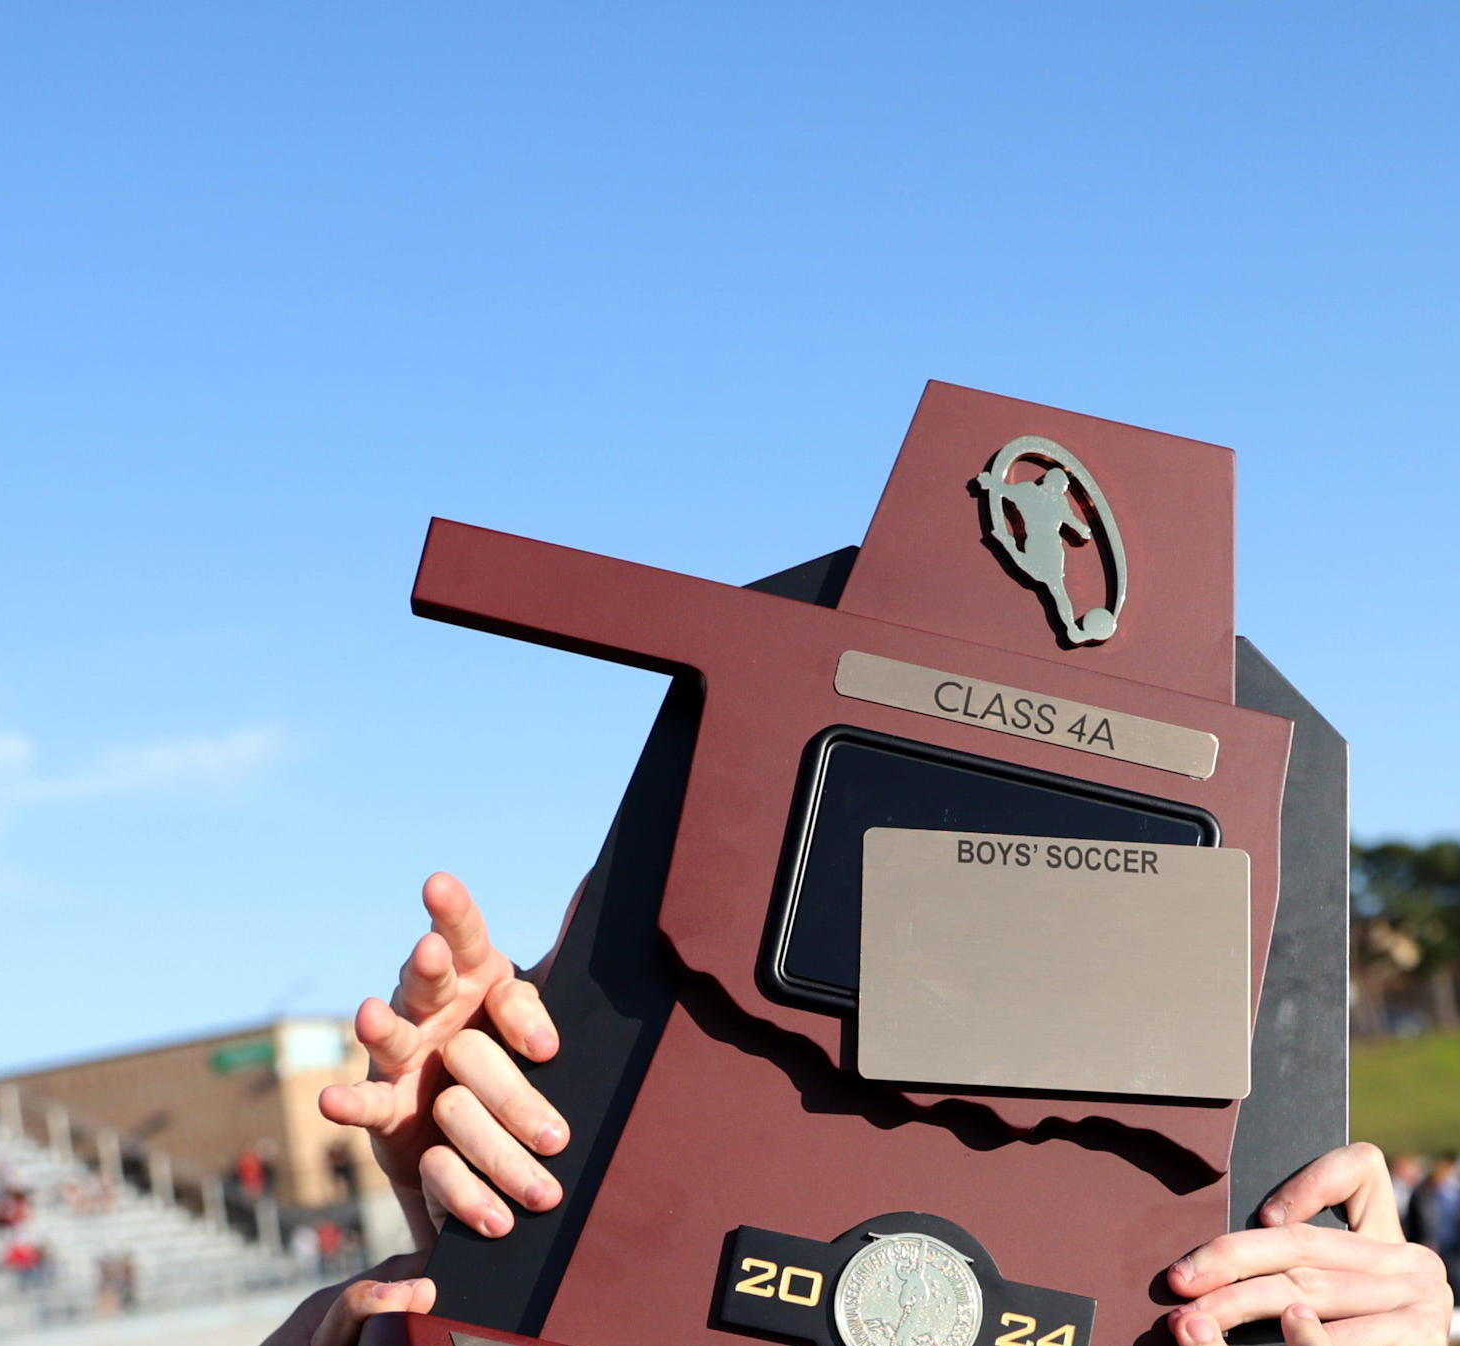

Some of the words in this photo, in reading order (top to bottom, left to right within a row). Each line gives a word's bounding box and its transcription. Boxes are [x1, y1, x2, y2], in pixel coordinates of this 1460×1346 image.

[933, 681, 1057, 736] CLASS
[1066, 713, 1115, 751] 4A
[956, 839, 1039, 867] BOYS'
[1045, 844, 1159, 875] SOCCER
[735, 1257, 824, 1308] 20
